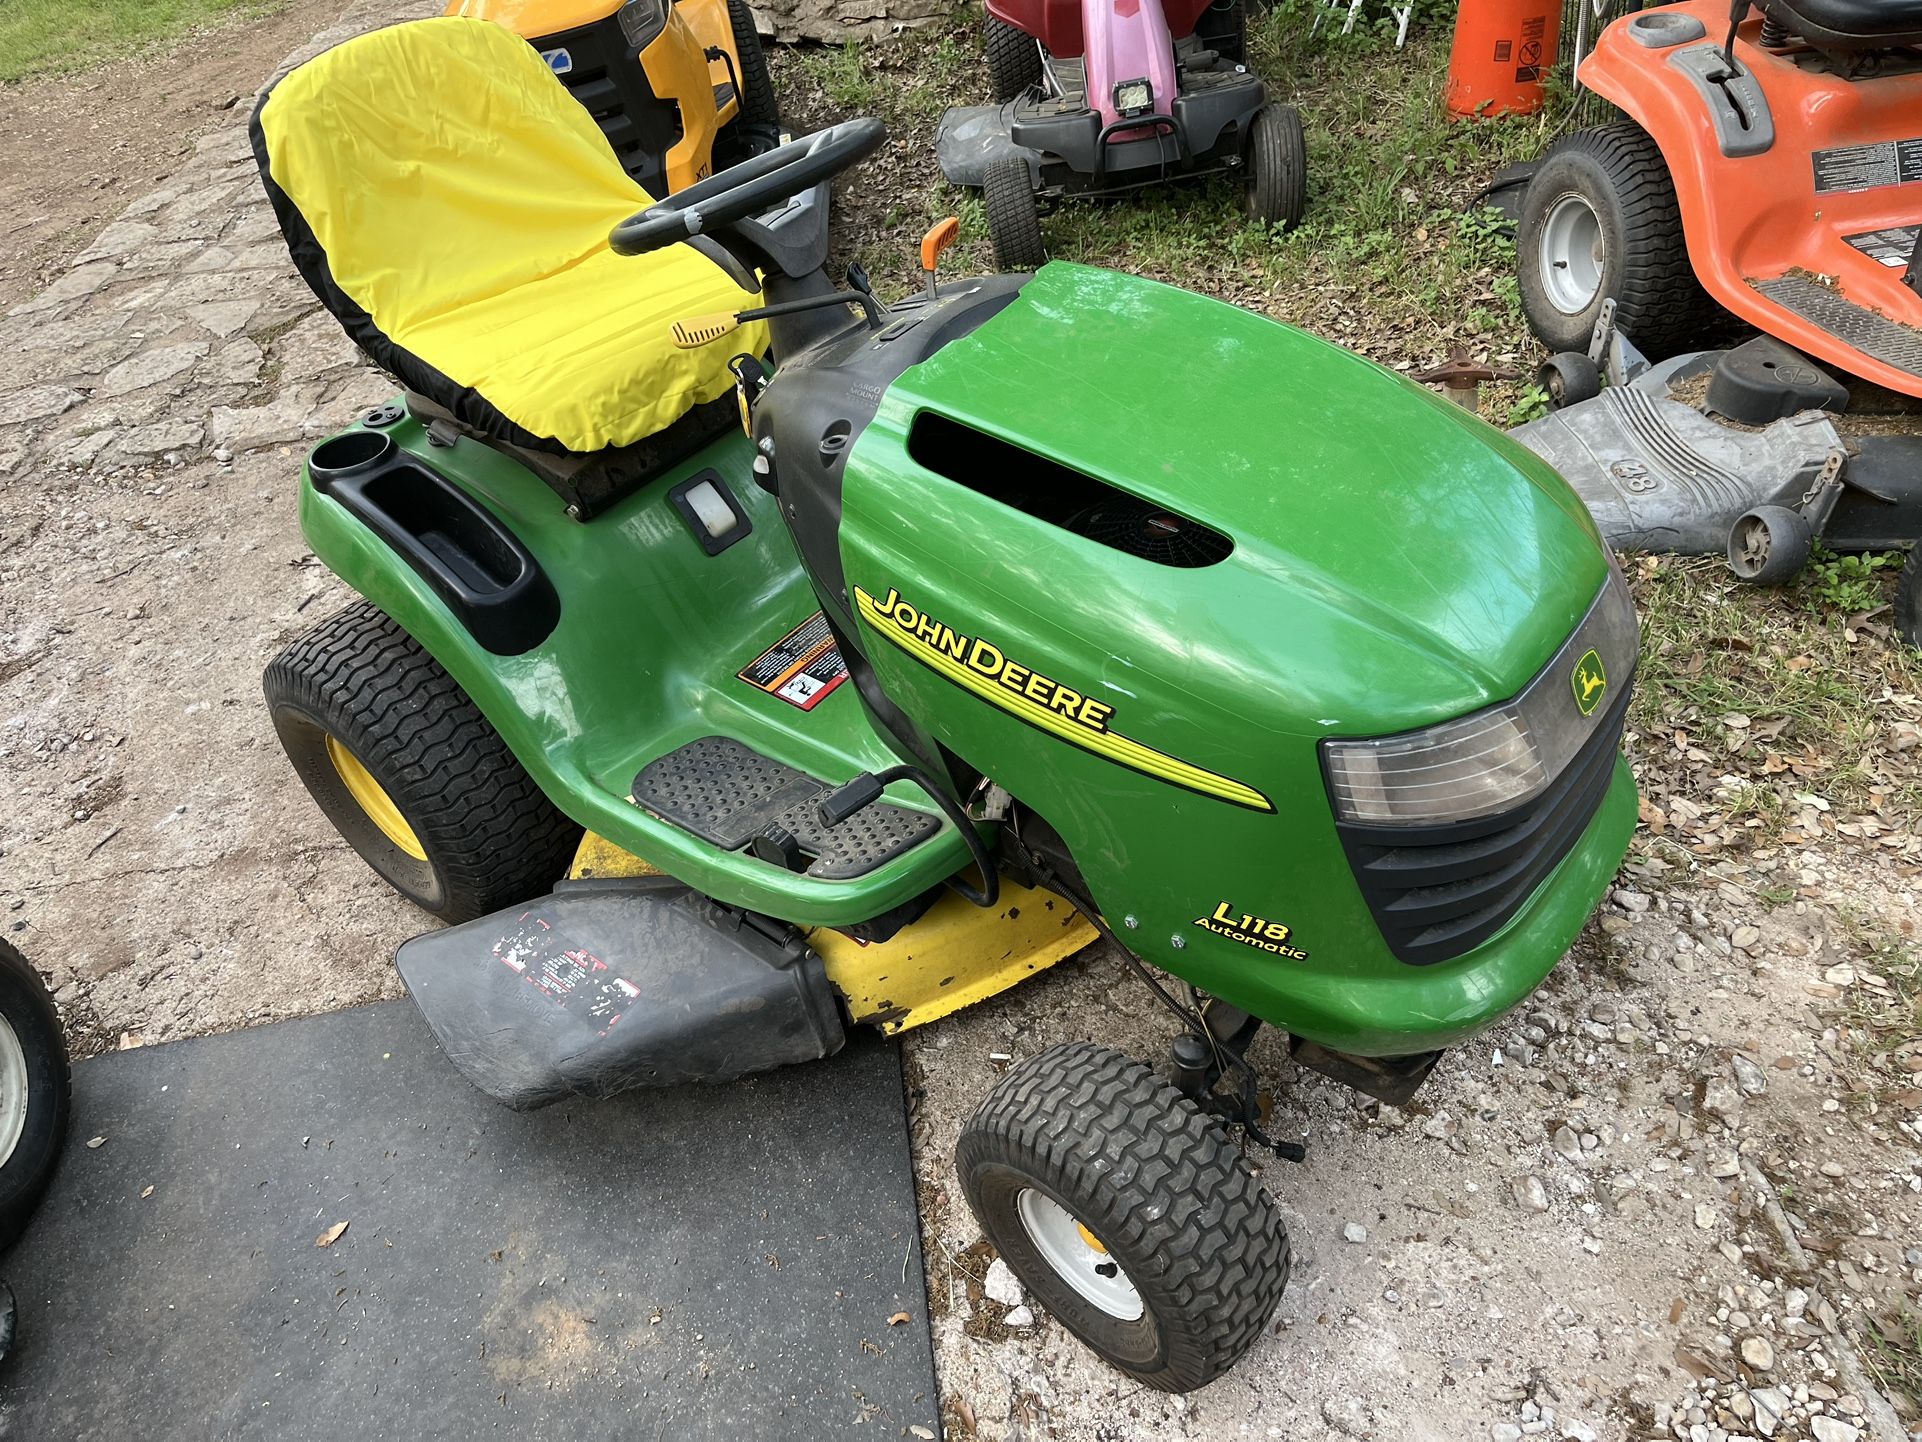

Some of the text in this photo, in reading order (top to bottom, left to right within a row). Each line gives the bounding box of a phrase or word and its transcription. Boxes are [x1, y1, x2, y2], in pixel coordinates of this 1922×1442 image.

[850, 386, 880, 401] MOUNT
[1613, 462, 1658, 493] 48
[872, 588, 968, 661] JOHN
[967, 637, 1112, 730] DEERE
[1194, 917, 1307, 960] Automatic
[1212, 901, 1290, 941] L118
